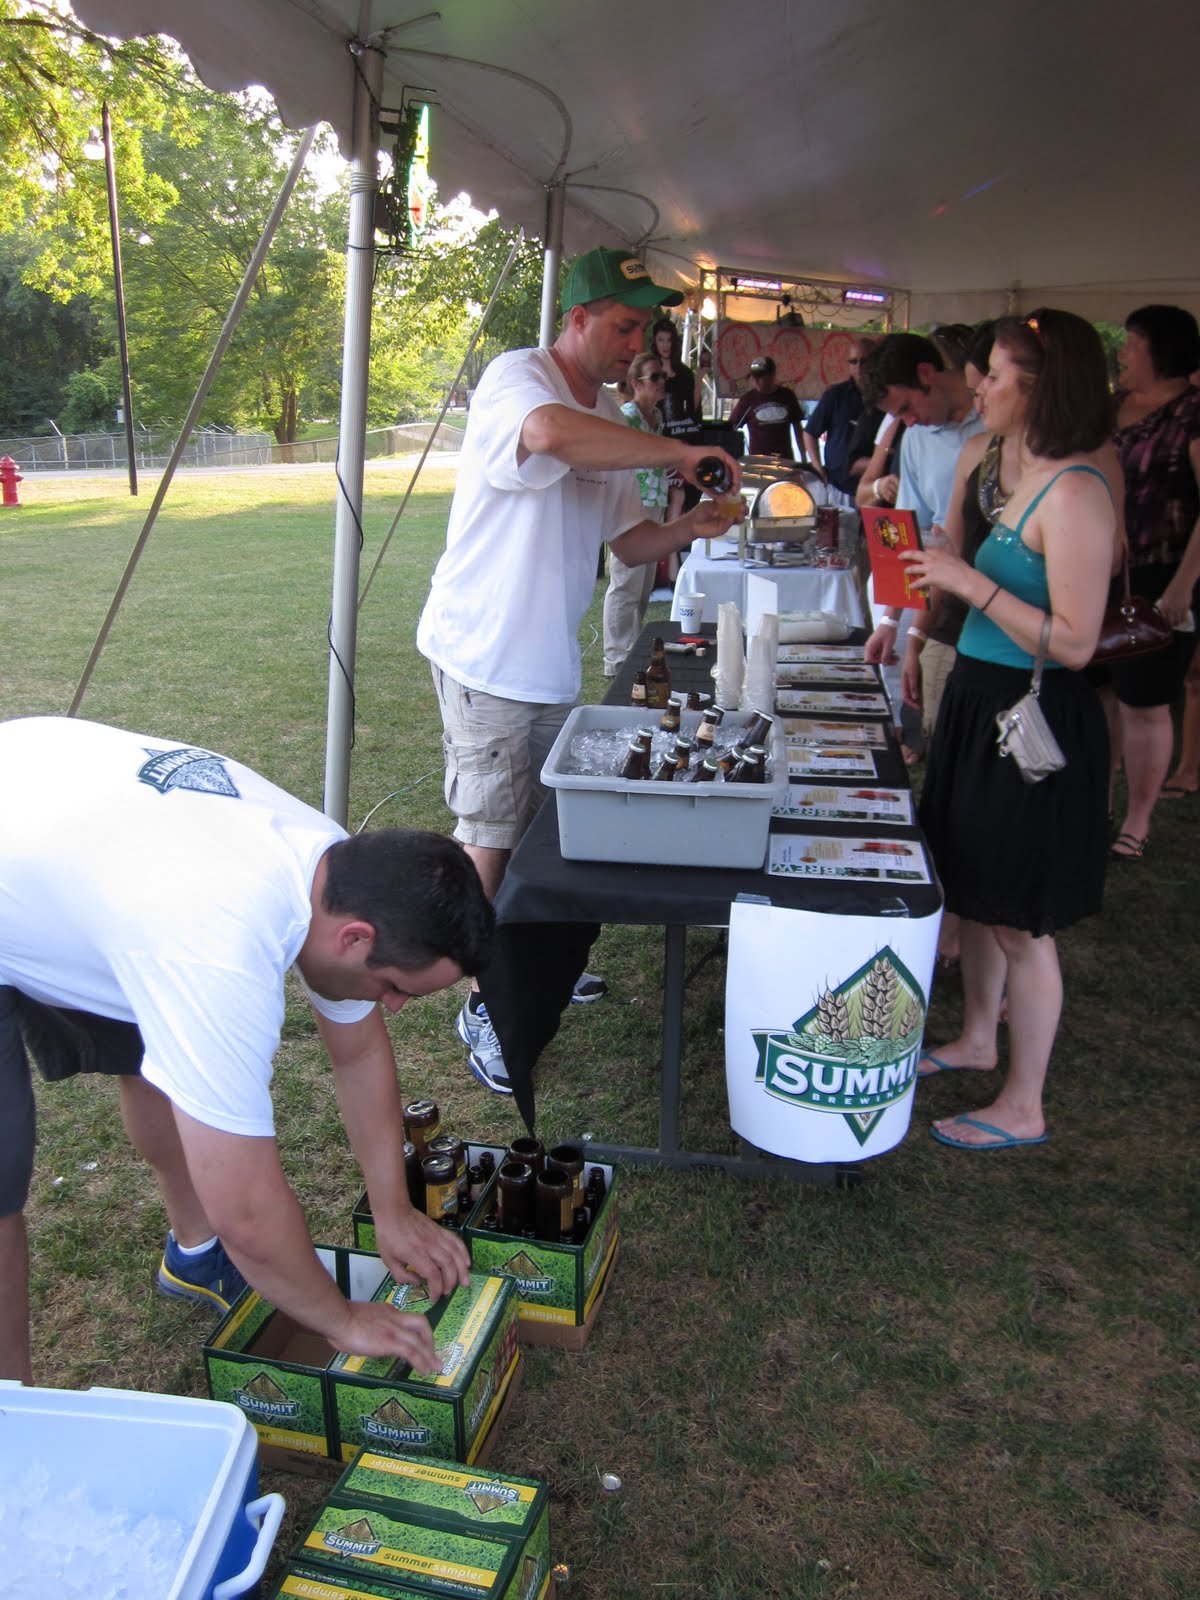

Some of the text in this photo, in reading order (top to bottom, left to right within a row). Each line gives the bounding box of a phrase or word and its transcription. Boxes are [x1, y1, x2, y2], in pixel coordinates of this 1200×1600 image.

[148, 749, 212, 784] SUMMIT
[771, 1051, 917, 1096] SUMMI
[516, 1280, 548, 1290] MMIT
[240, 1395, 294, 1413] SUMMIT
[367, 1421, 425, 1440] SUMMIT
[470, 1483, 518, 1498] SUMMIT
[325, 1535, 377, 1552] SUMMIT
